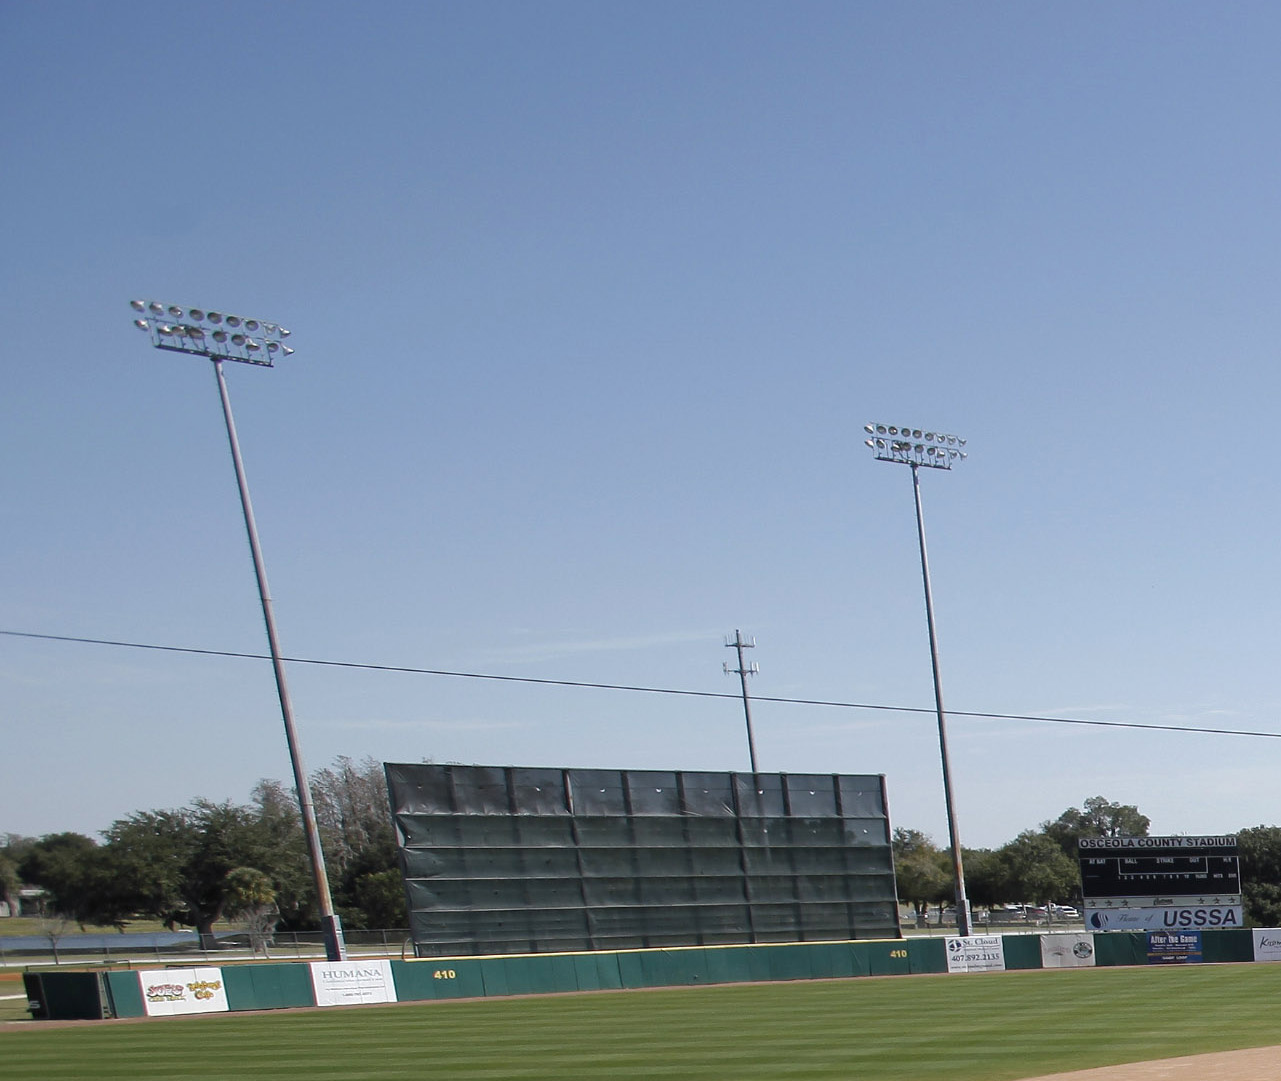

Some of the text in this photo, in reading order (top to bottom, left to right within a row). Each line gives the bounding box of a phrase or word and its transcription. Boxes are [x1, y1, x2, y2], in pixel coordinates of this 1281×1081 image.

[1080, 836, 1236, 849] OSCEOLA COUNTY STADIUM
[1163, 909, 1237, 927] USSSA
[975, 937, 999, 946] Cloud
[1150, 935, 1198, 944] After the Game
[889, 950, 908, 959] 410
[322, 969, 382, 979] HUMANA
[433, 970, 456, 980] 410
